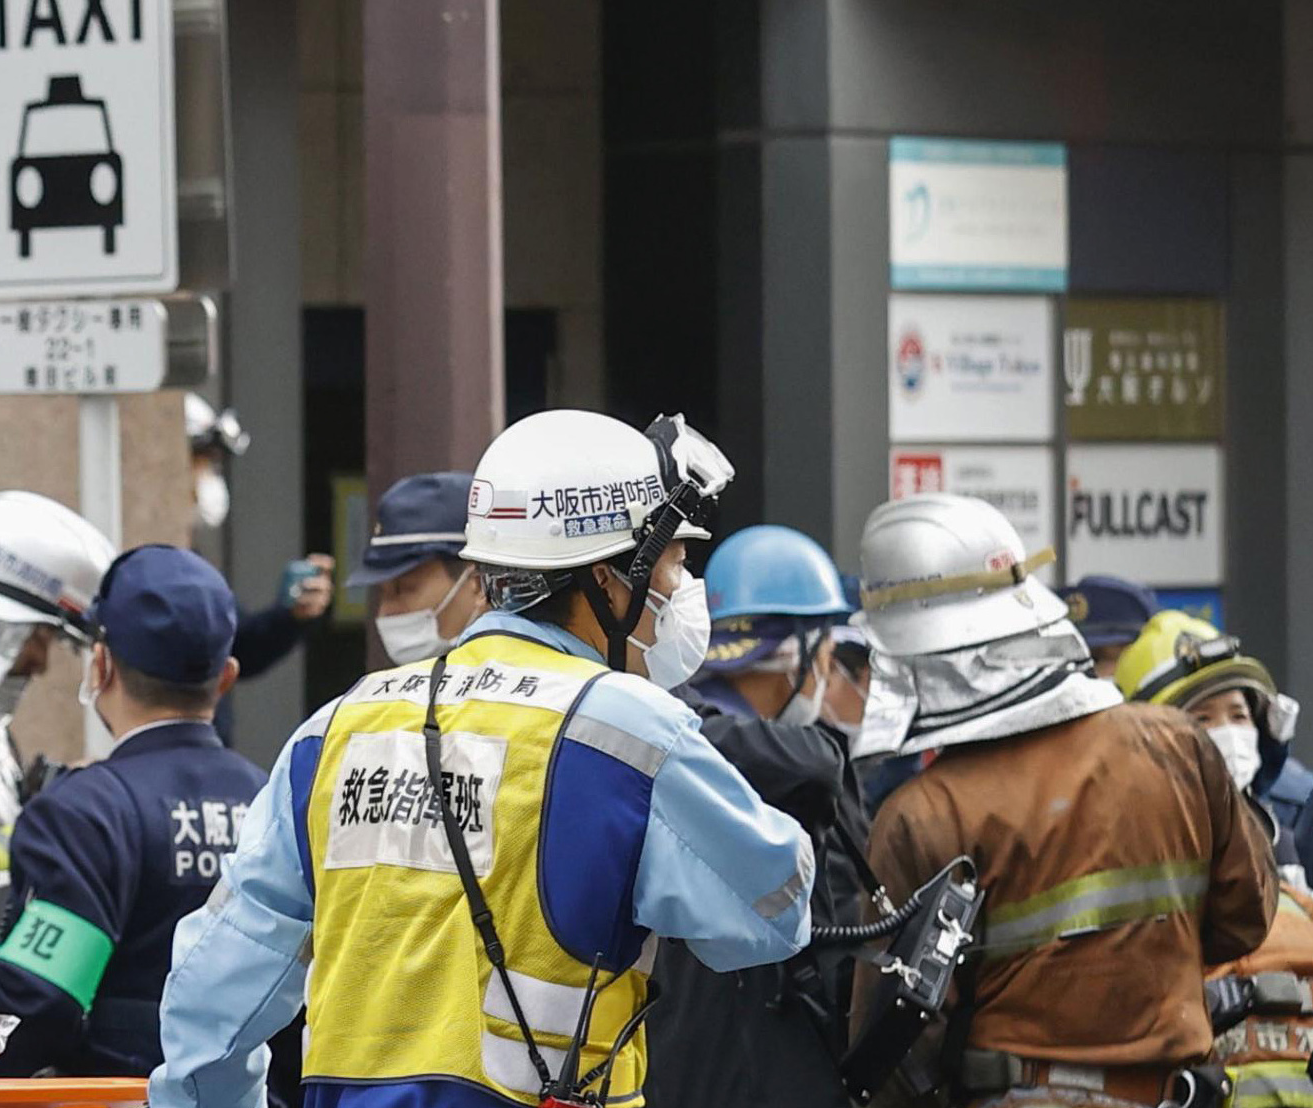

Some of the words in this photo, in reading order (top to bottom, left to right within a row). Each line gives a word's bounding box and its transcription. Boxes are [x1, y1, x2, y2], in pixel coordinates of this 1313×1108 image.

[531, 474, 666, 520] 大阪市消防局
[1070, 490, 1207, 536] FULLCAST
[565, 513, 629, 536] 救急救命
[338, 766, 484, 833] 救急指揮班
[175, 850, 225, 877] PO
[19, 916, 65, 960] 犯
